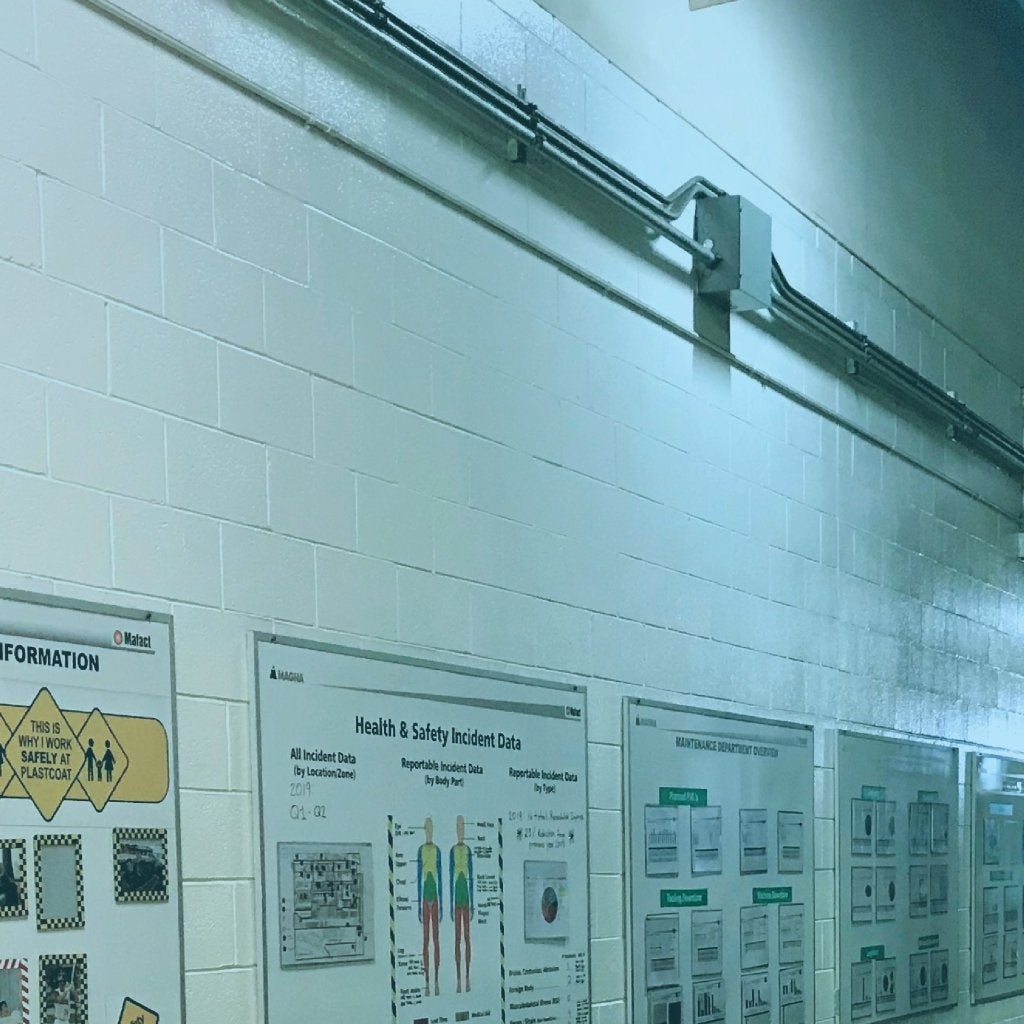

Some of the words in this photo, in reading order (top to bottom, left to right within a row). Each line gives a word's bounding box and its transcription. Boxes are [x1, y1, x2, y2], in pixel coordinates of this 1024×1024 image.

[124, 631, 151, 648] Mafact
[30, 720, 49, 734] THIS
[52, 721, 61, 734] IS
[355, 716, 396, 738] Health
[400, 721, 408, 739] &
[412, 722, 448, 747] Safety
[452, 727, 495, 748] Incident
[497, 732, 522, 751] Data
[19, 735, 39, 748] WHY
[46, 737, 72, 750] WORK
[676, 736, 716, 751] MAINTENANCE
[718, 742, 752, 755] DEPARTMENT
[21, 751, 58, 764] SAFELY
[60, 753, 70, 764] AT
[290, 748, 301, 760] All
[303, 749, 336, 763] Incident
[338, 752, 357, 764] Data
[20, 767, 72, 780] PLASTCOAT
[294, 765, 305, 778] (by
[401, 758, 439, 772] Reportable
[441, 761, 467, 773] Incident
[468, 764, 483, 774] Data
[425, 775, 434, 787] (by
[435, 776, 450, 787] Body
[451, 777, 464, 787] Part)
[509, 767, 540, 780] Reportable
[541, 770, 564, 781] Incident
[565, 772, 578, 782] Data
[289, 782, 311, 796] 2019
